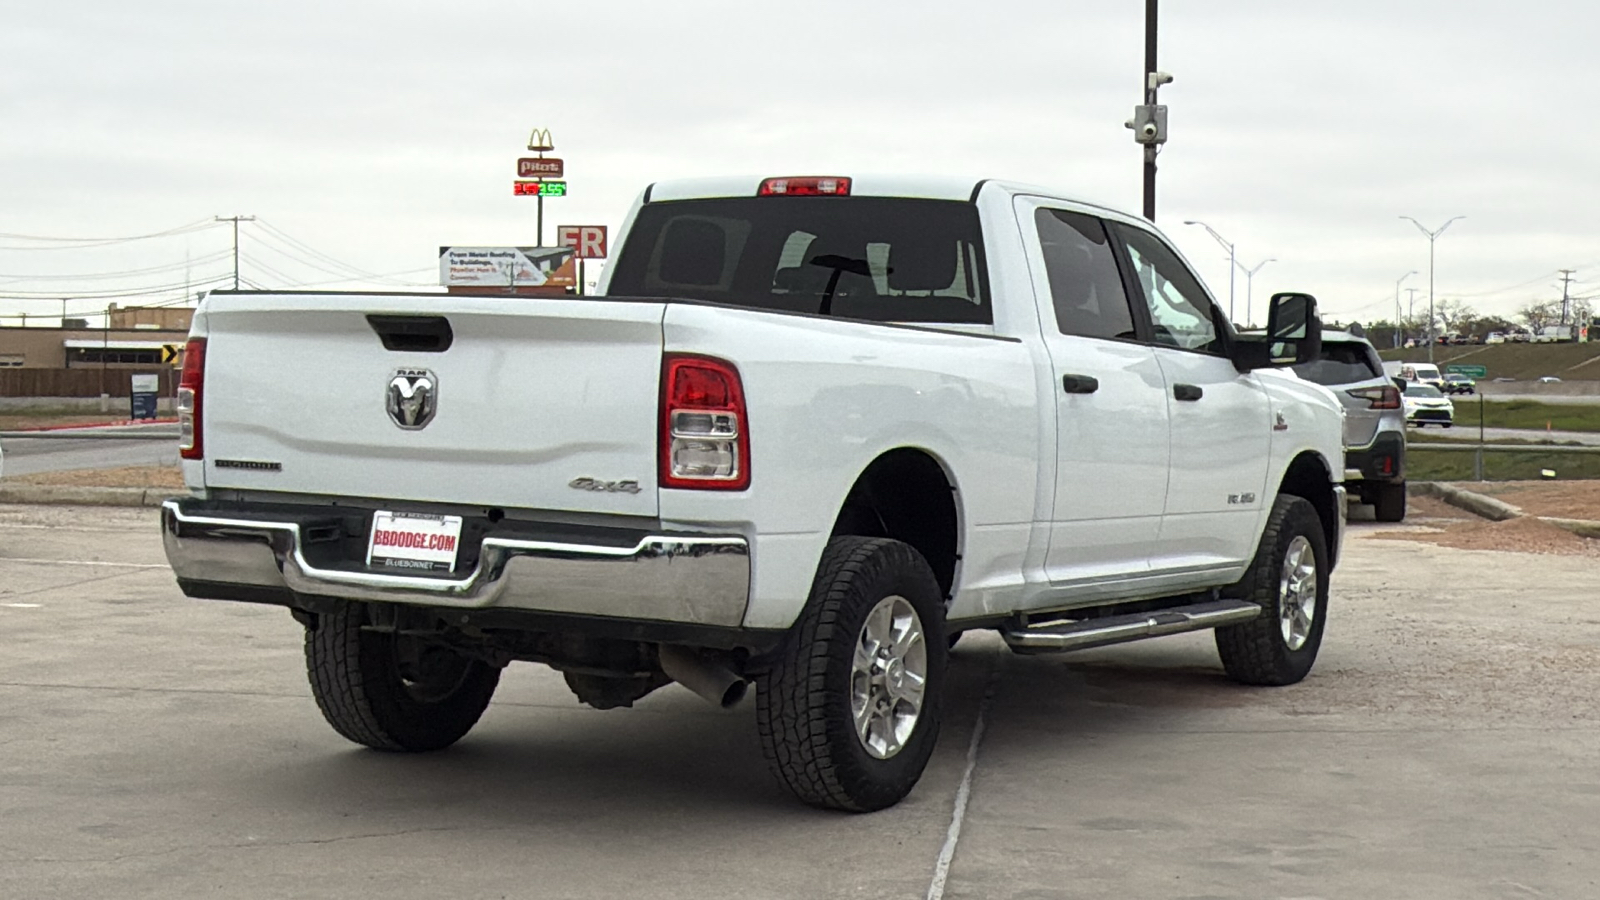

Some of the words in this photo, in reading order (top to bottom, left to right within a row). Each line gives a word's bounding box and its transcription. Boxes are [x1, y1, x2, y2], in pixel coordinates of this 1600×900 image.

[521, 161, 558, 173] Pilot
[489, 251, 516, 259] Roofing
[373, 529, 456, 552] BBDODGE.COM
[384, 558, 434, 570] BLUEBONNET
